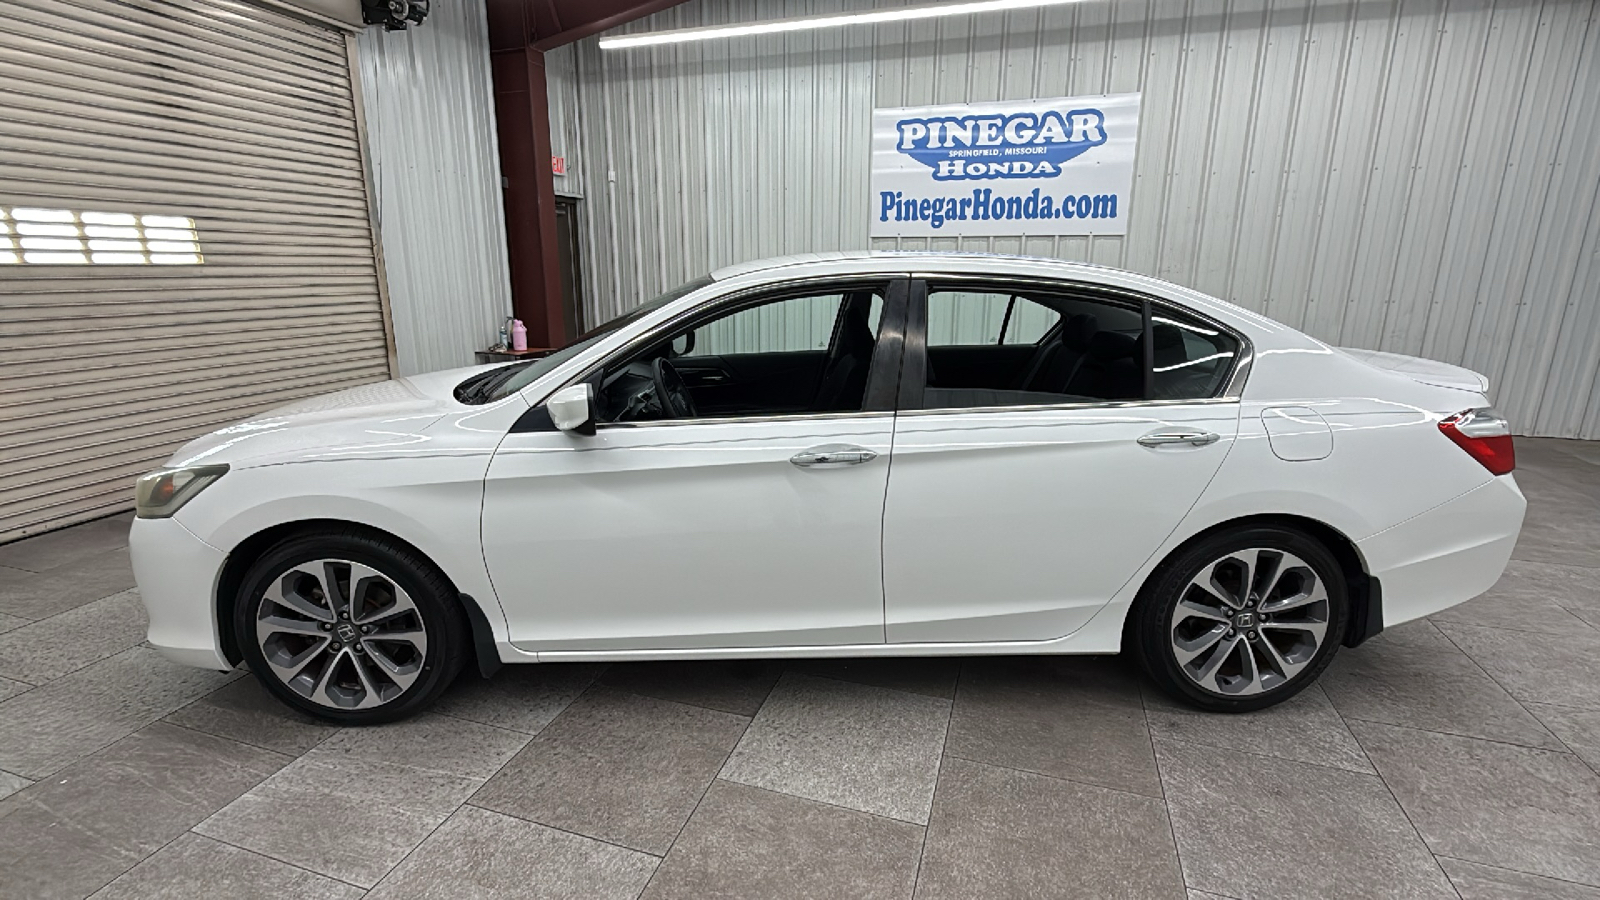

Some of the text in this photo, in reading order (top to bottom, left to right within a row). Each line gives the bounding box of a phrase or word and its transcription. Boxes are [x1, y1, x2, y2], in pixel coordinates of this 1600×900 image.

[901, 113, 1103, 149] PINEGAR
[1004, 147, 1047, 156] MISSOURI
[936, 160, 1056, 177] HONDA
[879, 188, 1118, 228] PinegarHonda.com
